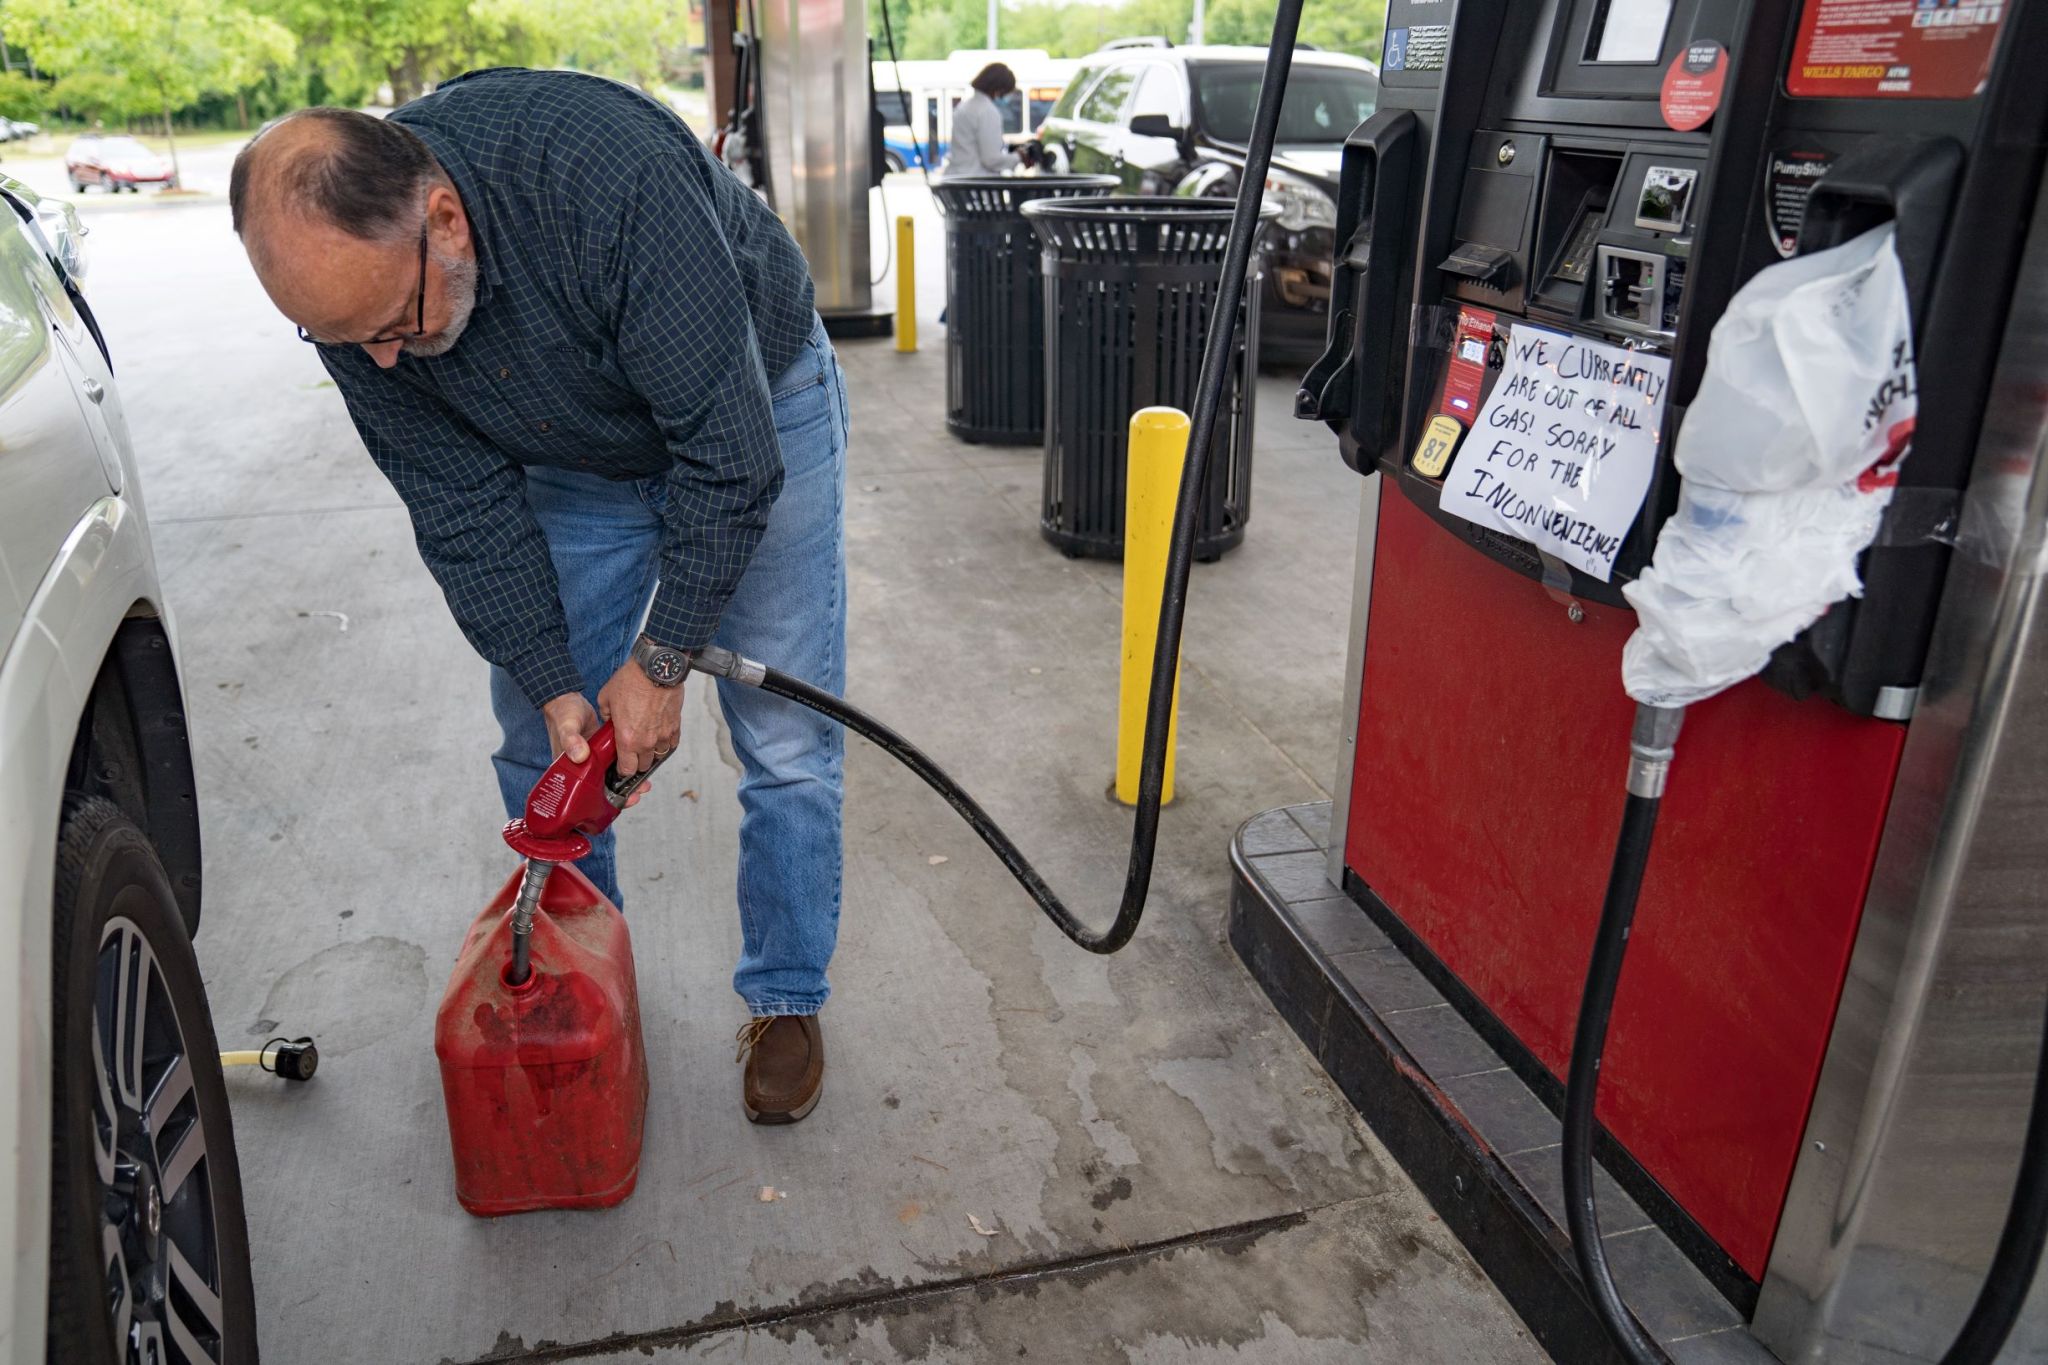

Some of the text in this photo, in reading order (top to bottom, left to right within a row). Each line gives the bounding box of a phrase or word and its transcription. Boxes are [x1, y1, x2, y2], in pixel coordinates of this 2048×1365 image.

[1688, 54, 1699, 63] TO
[1803, 66, 1841, 78] WELLS
[1842, 65, 1885, 78] FARGO
[1513, 335, 1549, 366] WE
[1557, 344, 1665, 406] CURRENTLY
[1503, 373, 1540, 402] ARE
[1544, 385, 1580, 410] OUT
[1584, 399, 1606, 417] OF
[1609, 406, 1642, 430] ALL
[1423, 437, 1447, 462] 87
[1489, 404, 1536, 436] GAS!
[1545, 423, 1616, 460] SORRY
[1487, 440, 1584, 488] FOR THE
[1465, 468, 1620, 563] INCONVENIENCE
